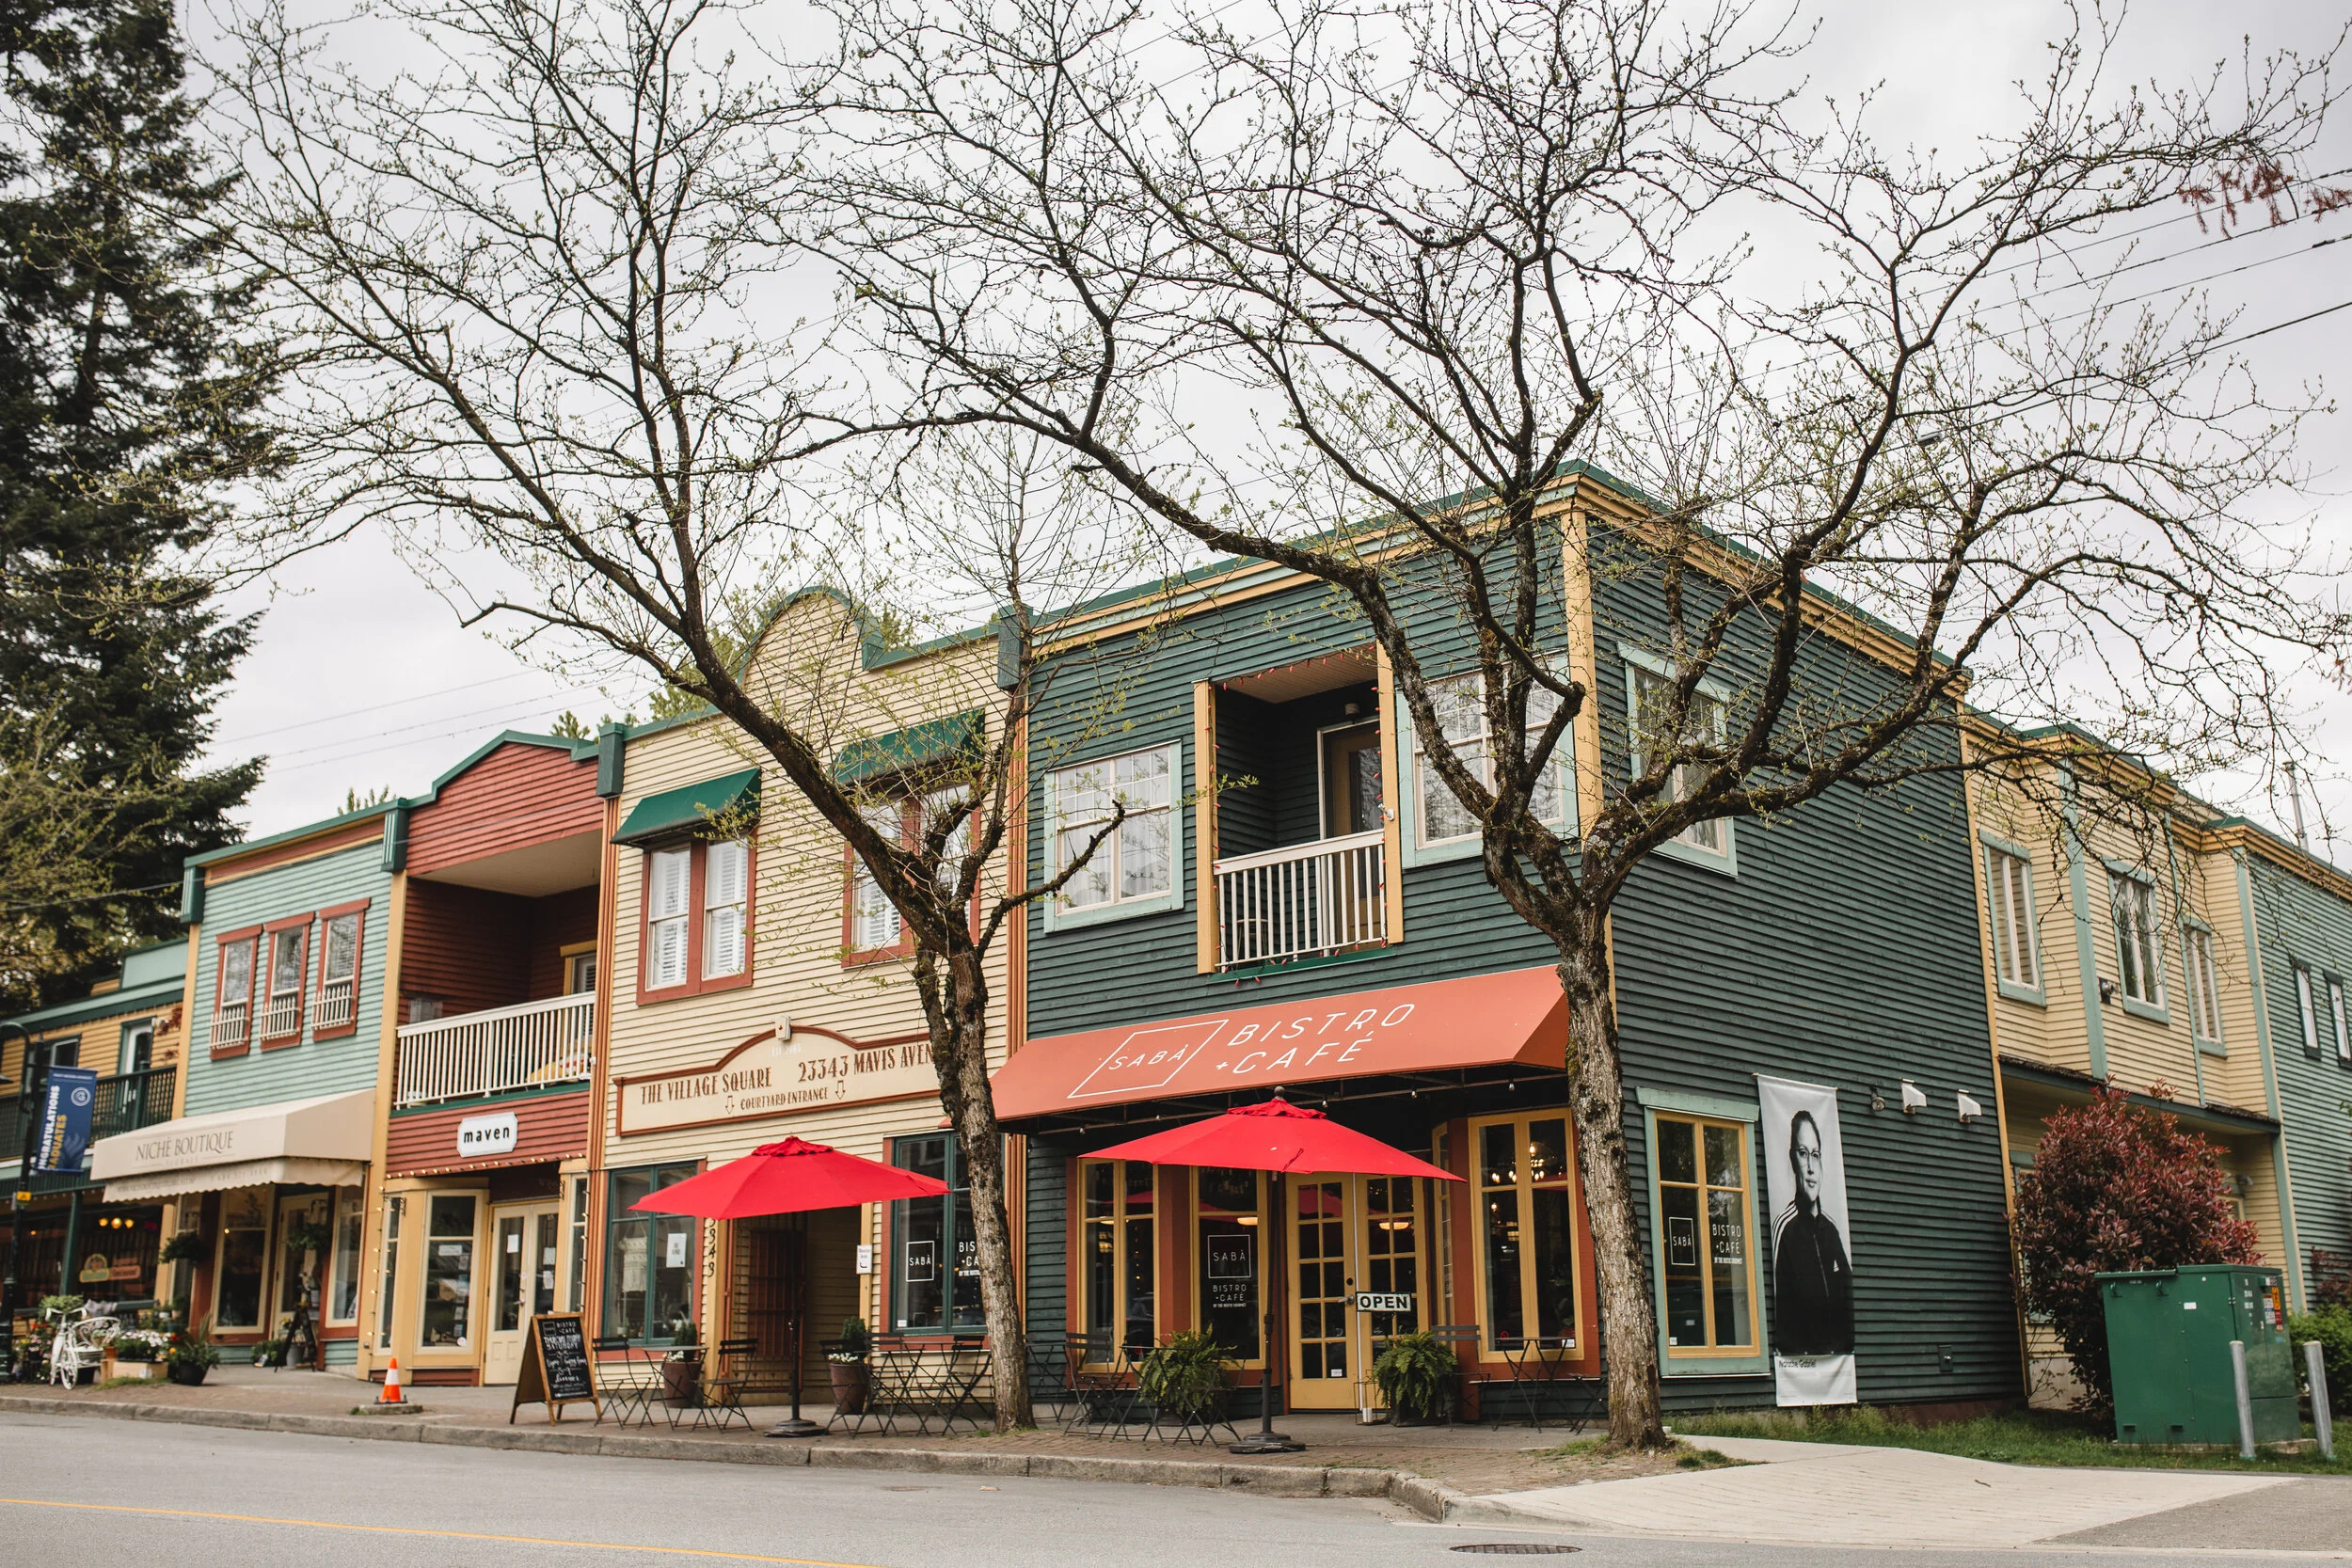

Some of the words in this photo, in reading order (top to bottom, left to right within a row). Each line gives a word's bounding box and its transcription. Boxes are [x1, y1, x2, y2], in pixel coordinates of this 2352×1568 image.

[1227, 1004, 1415, 1046] BISTRO
[798, 1054, 849, 1083] 23343
[853, 1048, 896, 1075] MAVIS
[900, 1044, 934, 1068] AVEN
[641, 1083, 663, 1104] THE
[667, 1075, 718, 1101] VILLAGE
[722, 1067, 772, 1093] SQUARE
[740, 1094, 787, 1110] COURTYARD
[787, 1086, 829, 1104] ENTRANCE
[38, 1085, 60, 1169] NGRATULATIONS
[463, 1127, 510, 1143] maven
[48, 1114, 67, 1169] RADUATES
[174, 1131, 234, 1153] BOUTIQUE
[1712, 1224, 1741, 1238] BISTRO
[959, 1241, 976, 1253] BIS
[961, 1256, 979, 1267] +CA
[1213, 1284, 1247, 1292] BISTRO
[1359, 1295, 1408, 1308] OPEN
